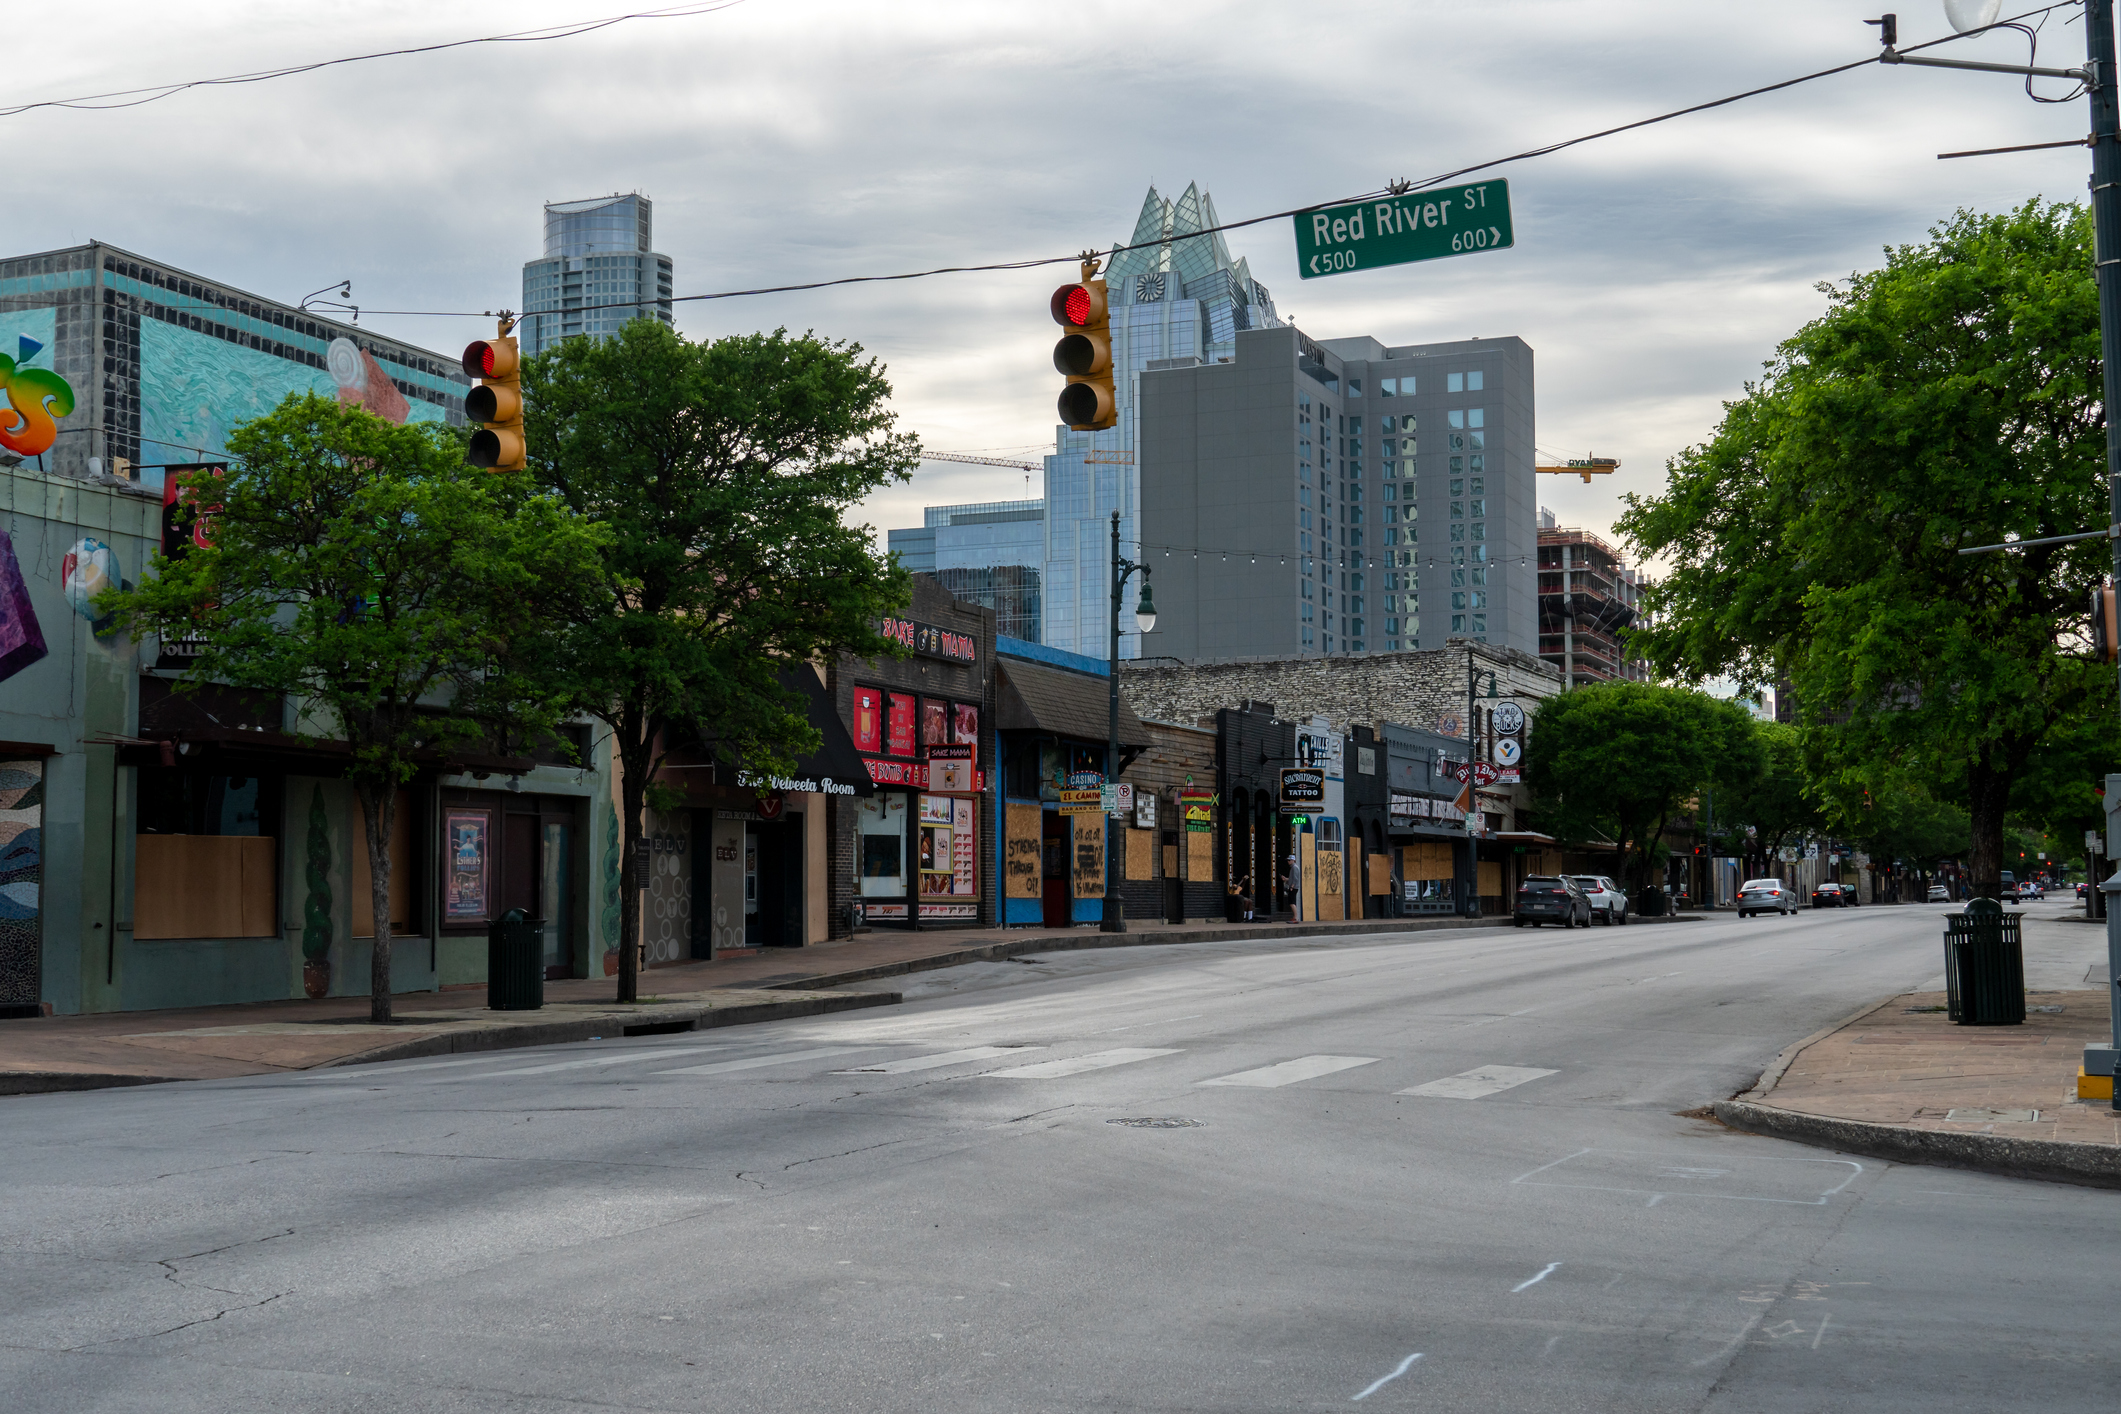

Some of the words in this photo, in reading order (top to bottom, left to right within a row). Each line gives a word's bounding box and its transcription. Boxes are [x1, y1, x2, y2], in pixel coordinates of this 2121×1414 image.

[1312, 207, 1365, 247] Red
[1375, 199, 1452, 236] River
[1464, 185, 1487, 210] ST
[1452, 228, 1487, 252] 600
[1322, 249, 1357, 272] 500
[1298, 331, 1325, 367] WESTIN
[1568, 459, 1593, 467] RYAN
[883, 617, 914, 648] SAKE
[941, 631, 975, 660] MAMA
[1500, 707, 1515, 716] TWO
[1495, 720, 1520, 731] BUCKS
[932, 749, 948, 757] SAKE
[950, 749, 971, 757] MAMA
[878, 762, 902, 782] BOMB
[1070, 774, 1097, 784] CASINO
[1456, 765, 1479, 780] Diy
[1480, 764, 1498, 780] Dog
[769, 773, 818, 793] Velveeta
[821, 777, 856, 796] Room
[1064, 792, 1073, 801] EL
[1076, 792, 1101, 801] CAMIN
[760, 798, 779, 814] V
